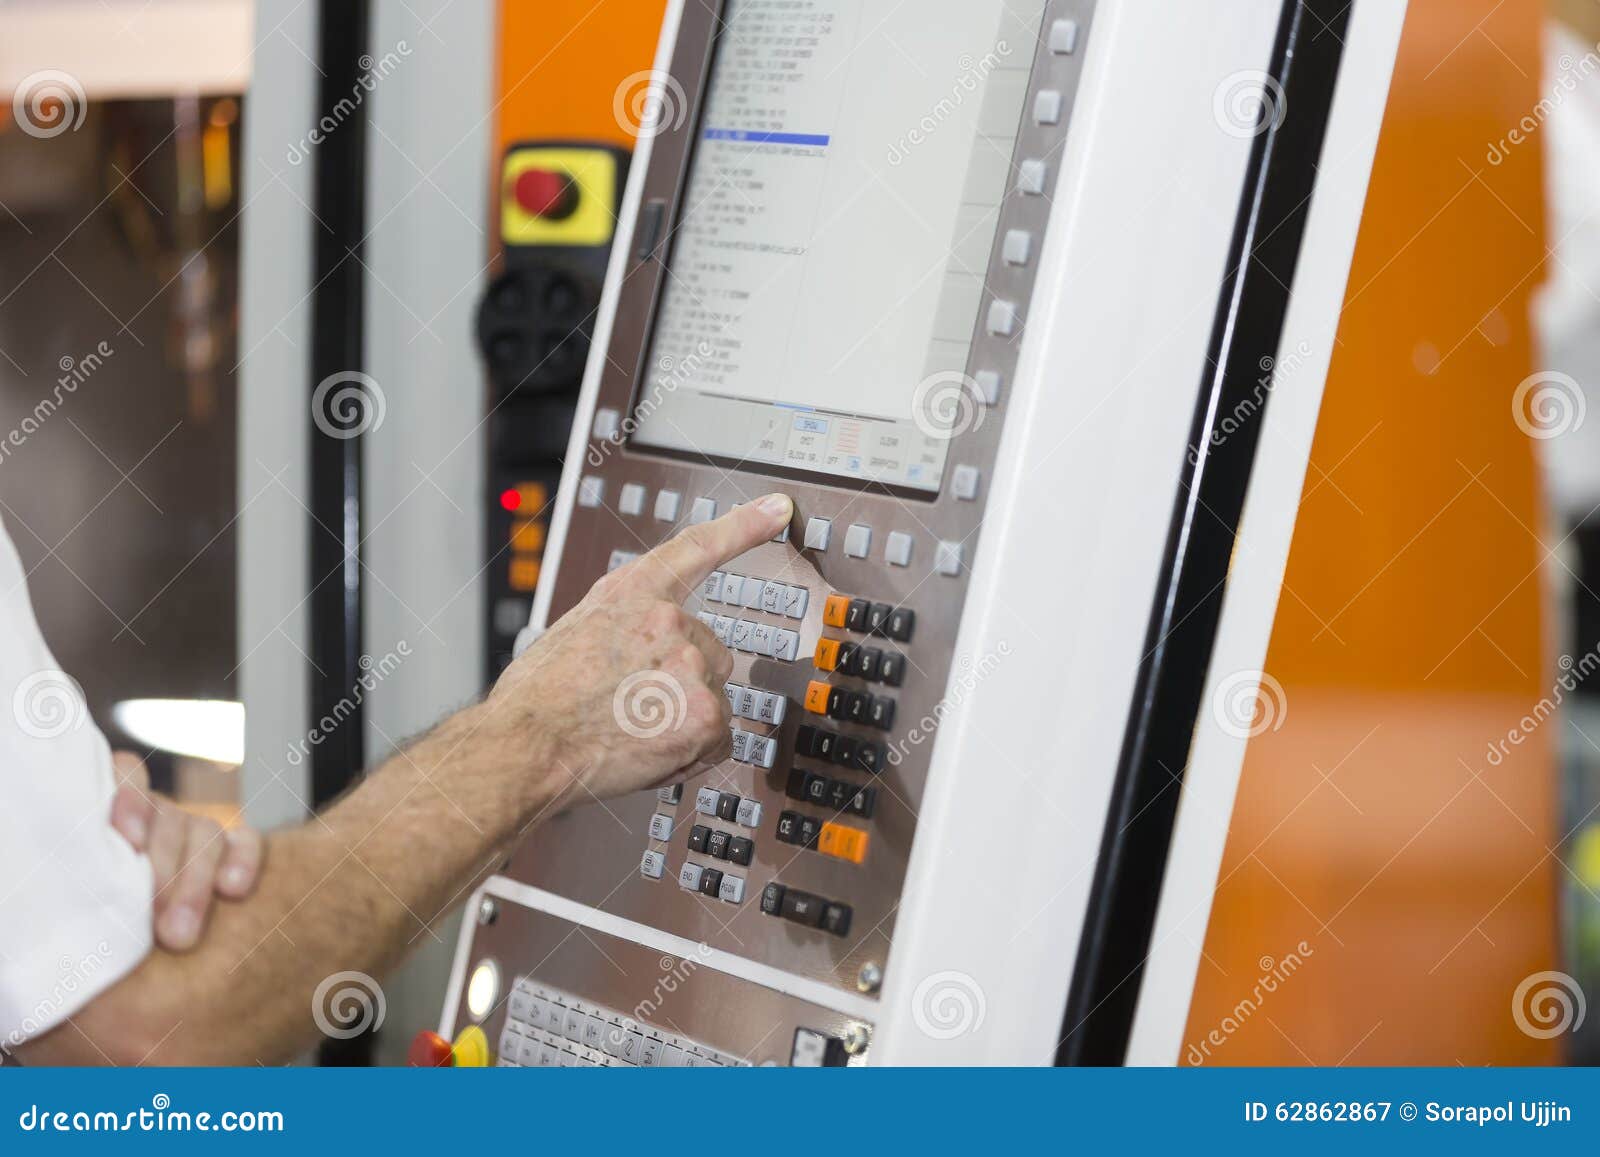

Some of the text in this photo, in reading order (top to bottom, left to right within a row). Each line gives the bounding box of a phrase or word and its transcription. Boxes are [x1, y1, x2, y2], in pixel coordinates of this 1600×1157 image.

[850, 607, 858, 622] 7
[841, 651, 848, 665] 4
[862, 655, 870, 671] 5
[853, 700, 860, 715] 2
[780, 819, 791, 834] CE
